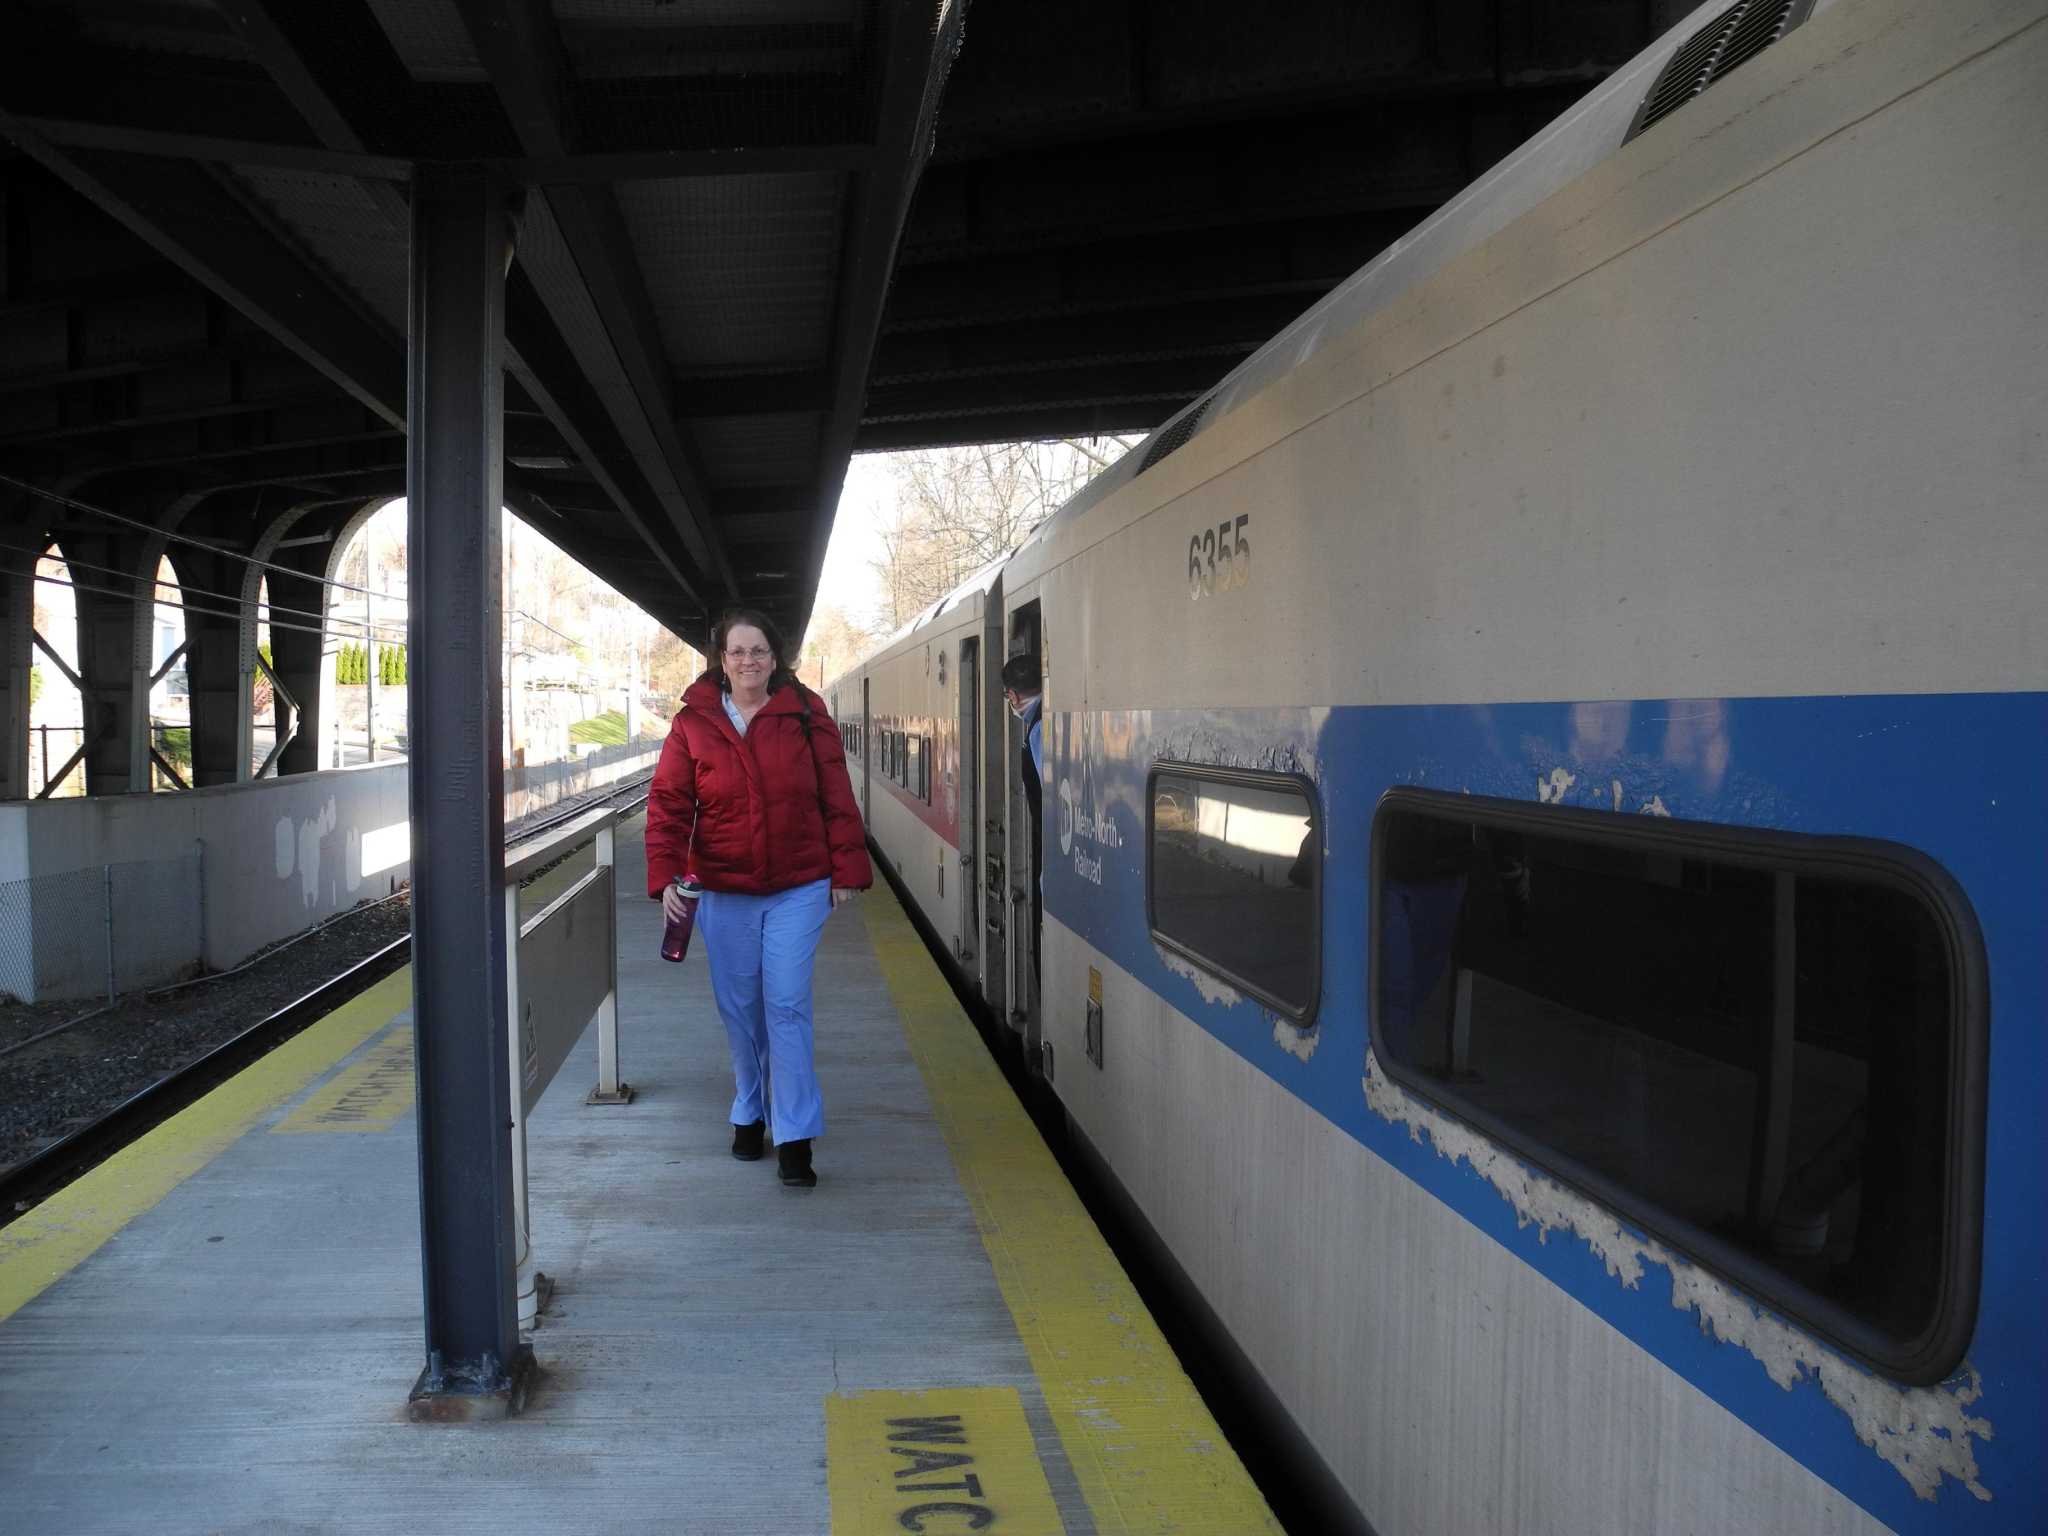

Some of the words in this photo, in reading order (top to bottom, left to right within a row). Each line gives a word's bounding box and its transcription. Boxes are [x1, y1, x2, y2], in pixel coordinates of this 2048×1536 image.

[1189, 513, 1250, 600] 6355
[1074, 806, 1117, 849] Metro-North
[884, 1415, 996, 1536] WATC
